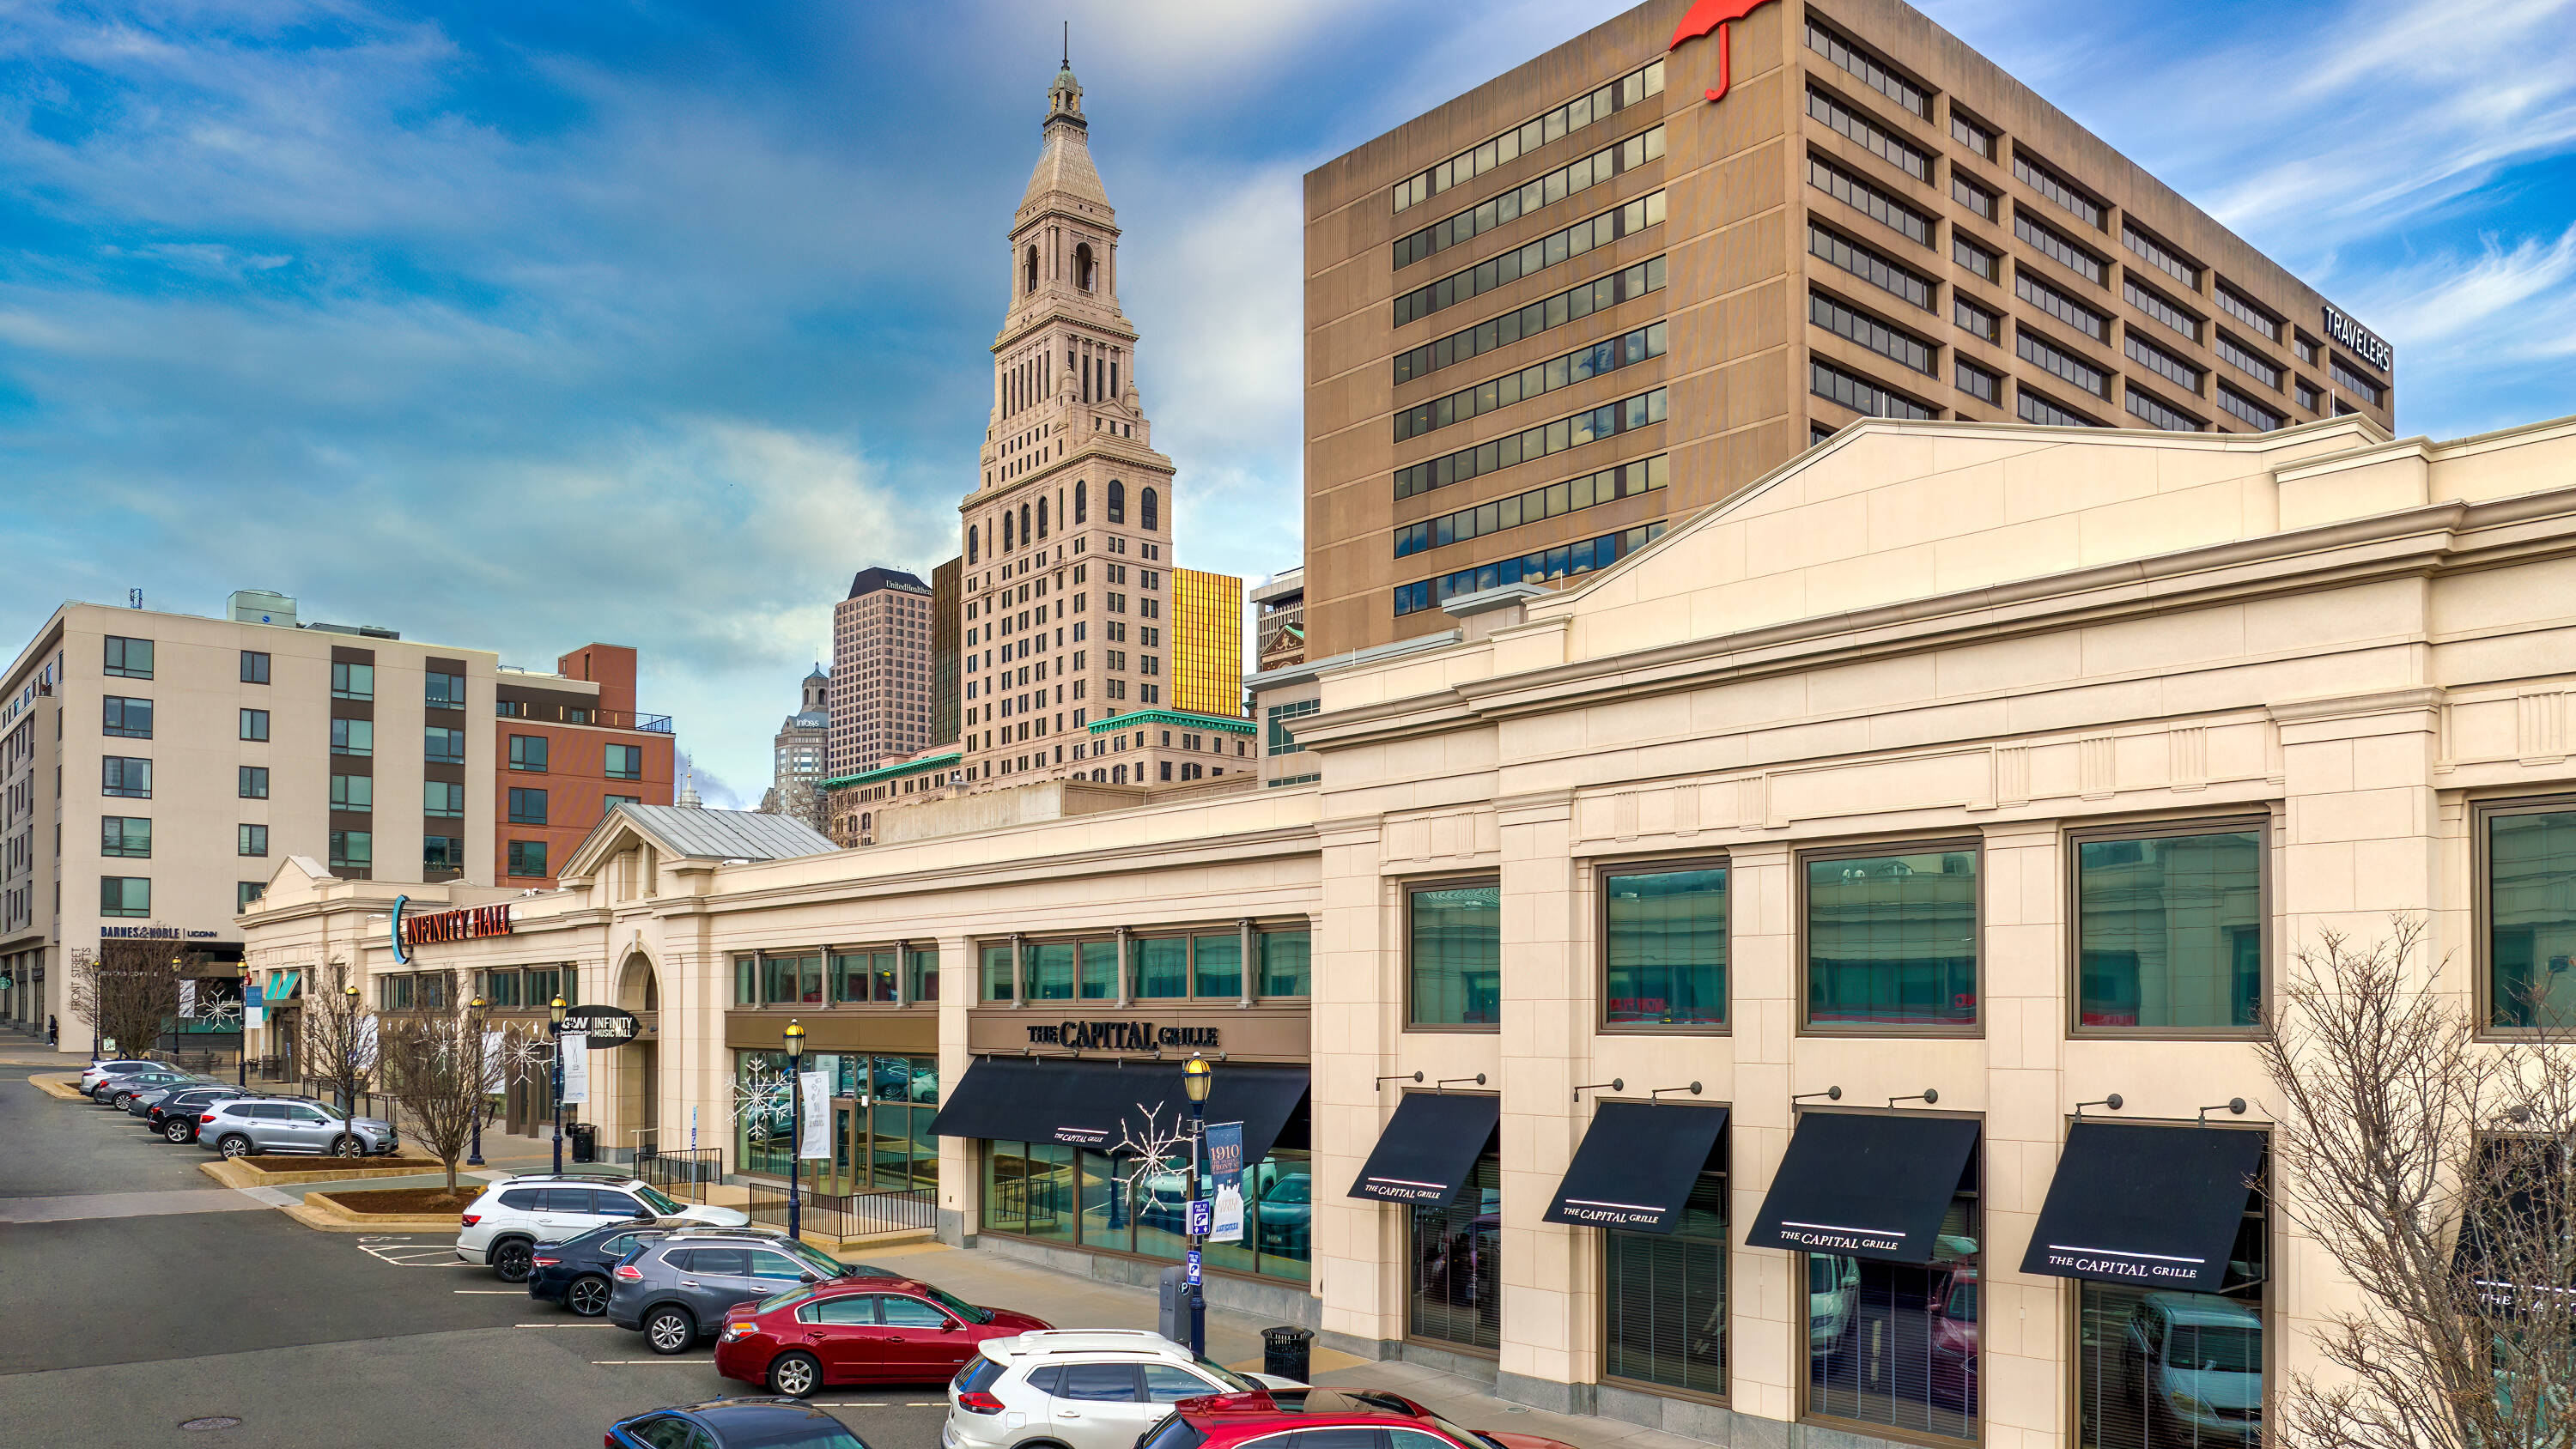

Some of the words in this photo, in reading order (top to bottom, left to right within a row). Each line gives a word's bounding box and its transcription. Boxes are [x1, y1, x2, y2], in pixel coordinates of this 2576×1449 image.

[2324, 306, 2390, 372] TRAVELERS
[886, 579, 933, 596] UnitedHealthca
[406, 910, 471, 945] INFINITY
[472, 904, 513, 937] HALL
[71, 947, 81, 979] STREET
[594, 1016, 633, 1029] INFINITY
[594, 1029, 615, 1038] MUSIC
[616, 1029, 632, 1038] HALL
[1027, 1026, 1060, 1043] THE
[1059, 1021, 1159, 1050] CAPITAL
[1158, 1027, 1219, 1046] GRILLE
[1062, 1134, 1087, 1143] CAPITAL
[1211, 1144, 1240, 1161] 1910
[1378, 1186, 1415, 1198] CAPITAL
[1417, 1190, 1441, 1199] GRILLE
[1564, 1207, 1580, 1216] THE
[1580, 1210, 1626, 1223] CAPITAL
[1629, 1214, 1659, 1223] GRILLE
[1781, 1230, 1801, 1240] THE
[1801, 1234, 1859, 1249] CAPITAL
[1862, 1239, 1899, 1250] GRILLE
[2049, 1255, 2075, 1266] THE
[2075, 1258, 2148, 1277] CAPITAL
[2152, 1266, 2197, 1278] GRILLE
[1182, 1282, 1188, 1294] P
